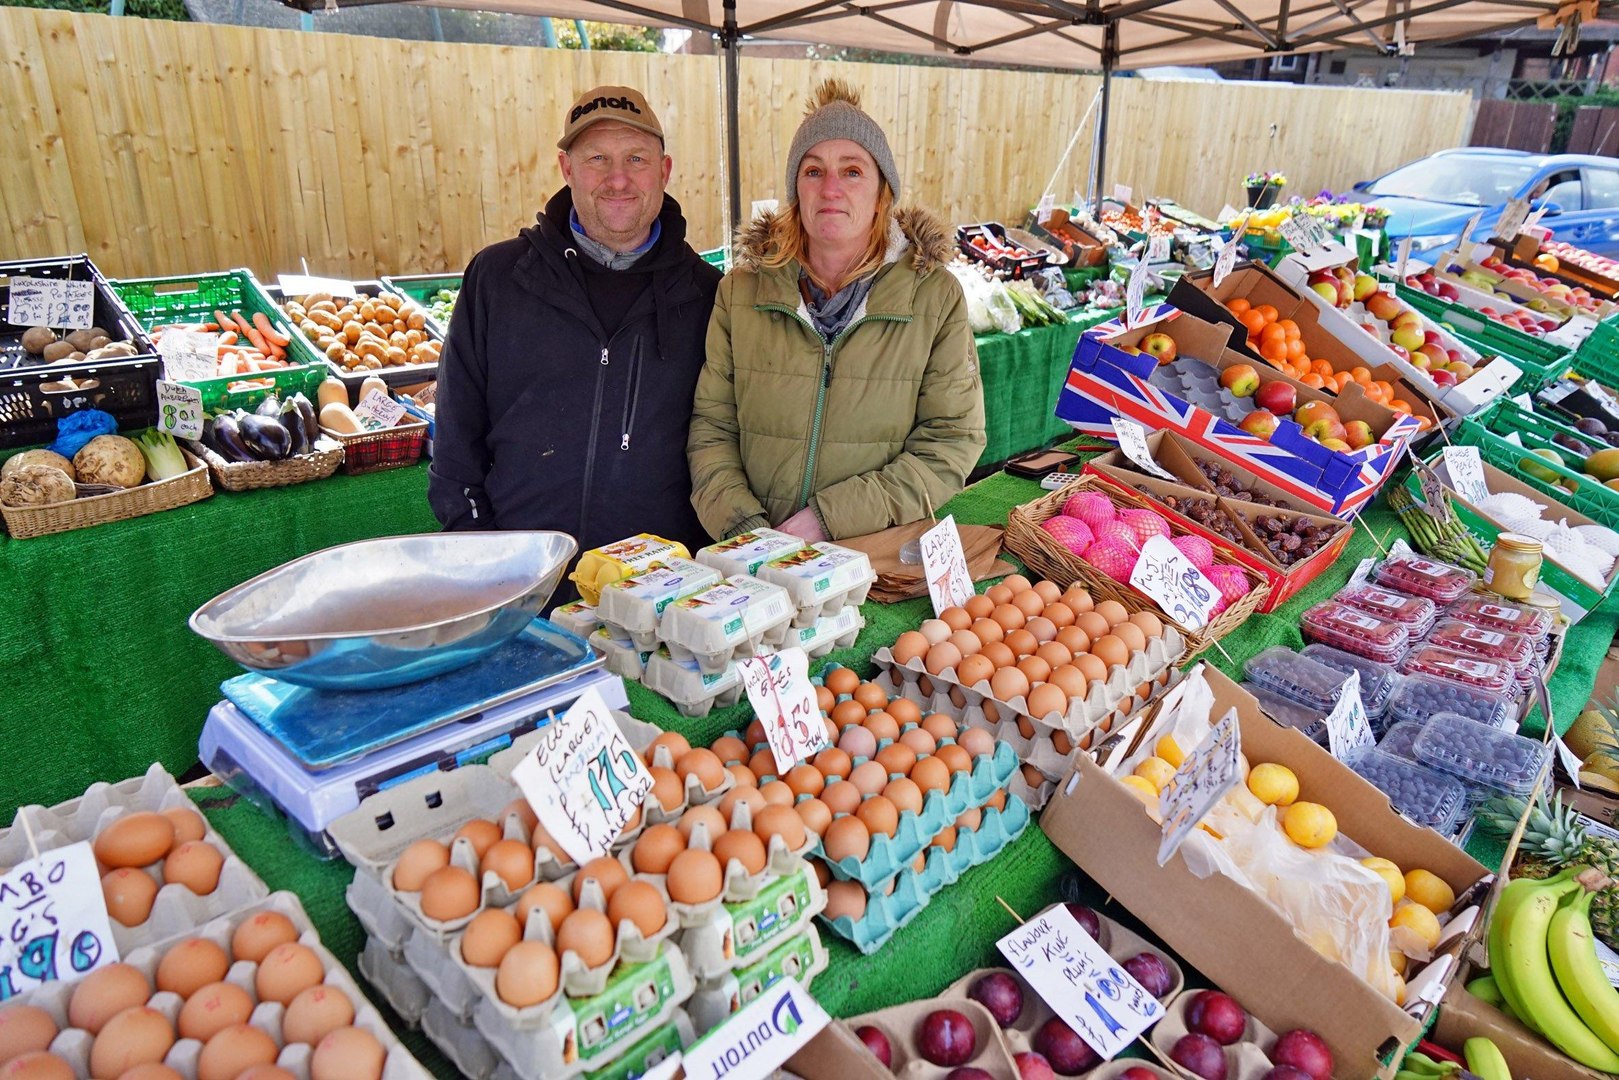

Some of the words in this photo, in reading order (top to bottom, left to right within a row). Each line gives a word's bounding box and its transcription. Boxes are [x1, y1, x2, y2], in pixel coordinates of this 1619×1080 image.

[571, 96, 641, 124] Bench.
[646, 543, 677, 558] RANGE
[711, 1021, 773, 1080] DUTOIT
